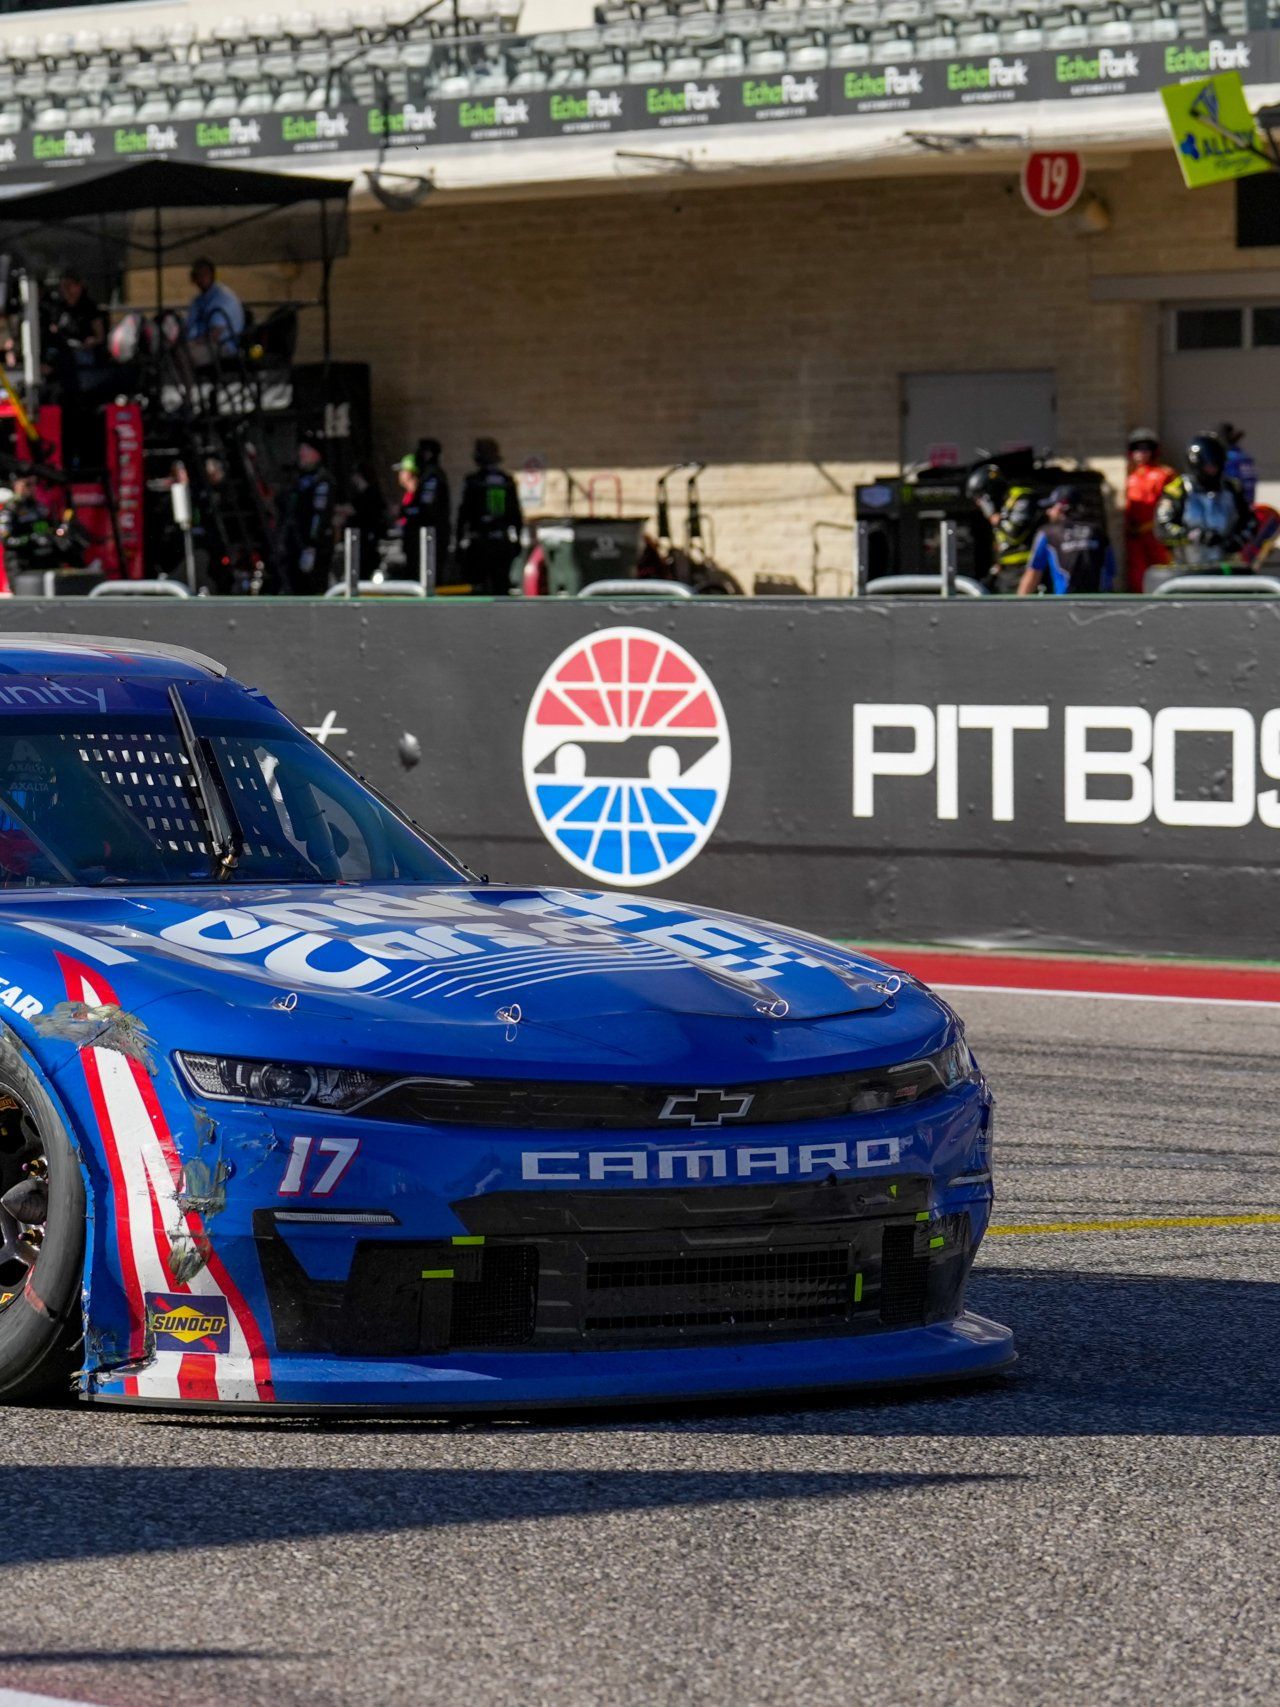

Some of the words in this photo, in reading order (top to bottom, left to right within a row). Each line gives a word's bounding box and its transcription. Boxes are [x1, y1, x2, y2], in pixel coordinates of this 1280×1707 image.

[1056, 49, 1139, 82] EchoPark
[1165, 40, 1250, 74] EchoPark
[844, 66, 923, 98] EchoPark
[947, 57, 1029, 91] EchoPark
[550, 89, 622, 120] EchoPark
[646, 82, 720, 115] EchoPark
[742, 74, 818, 107] EchoPark
[282, 111, 348, 141] EchoPark
[368, 103, 436, 134] EcoPark
[459, 96, 529, 128] EchoPark
[33, 130, 95, 159] EchoPark
[115, 124, 178, 153] EchoPark
[196, 117, 261, 147] EchoPark
[1040, 158, 1068, 200] 19
[852, 703, 1049, 822] PIT
[1064, 705, 1280, 829] BO
[279, 1136, 362, 1197] 17
[521, 1137, 902, 1181] CAMARO
[152, 1315, 225, 1335] SUNOCO
